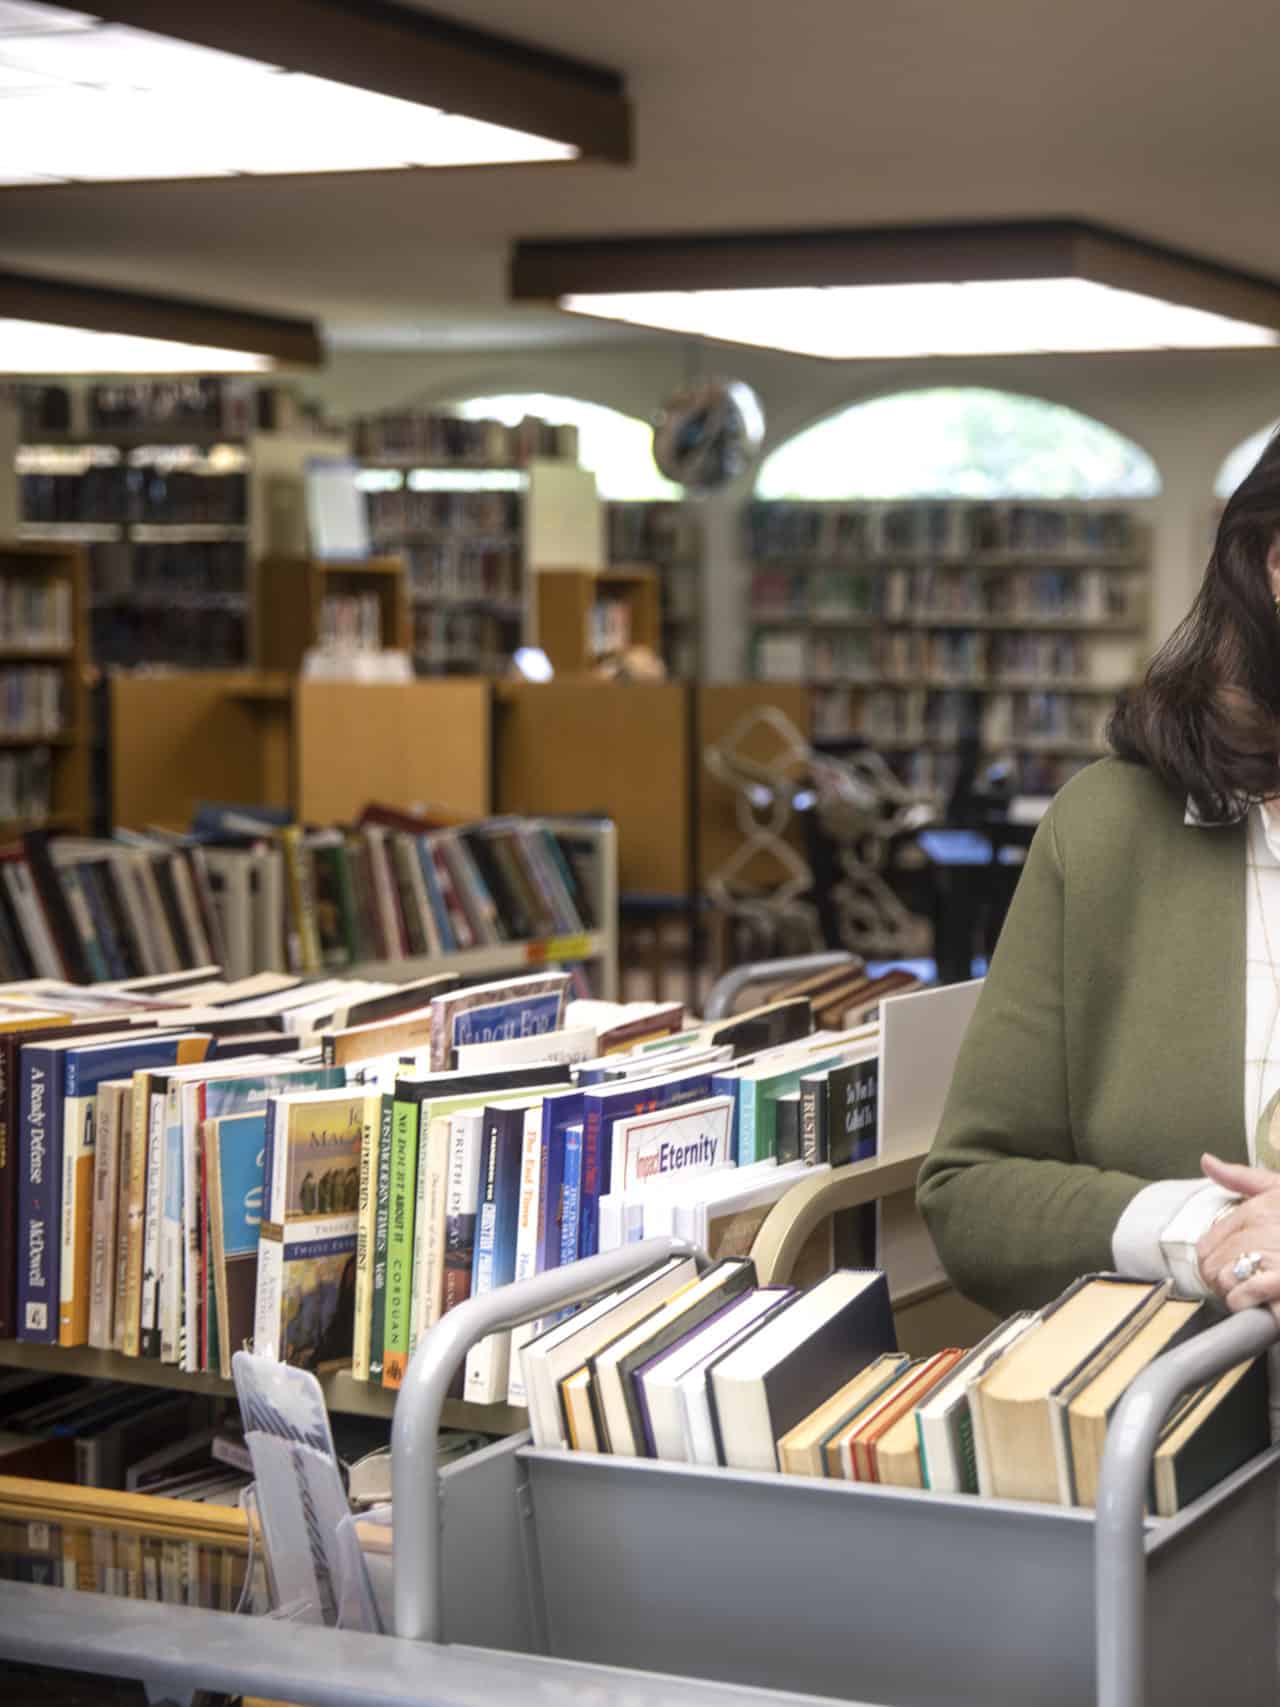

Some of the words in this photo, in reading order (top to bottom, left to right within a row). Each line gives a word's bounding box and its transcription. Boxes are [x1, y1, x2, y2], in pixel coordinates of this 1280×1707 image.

[32, 1067, 45, 1079] A
[27, 1083, 44, 1124] Ready
[29, 1128, 44, 1184] Defense
[378, 1109, 391, 1203] POSTMODERN
[396, 1138, 408, 1190] DOUBT
[453, 1128, 465, 1185] TRUTH
[659, 1133, 719, 1173] Eternity
[376, 1209, 388, 1252] TIMES
[393, 1232, 404, 1243] IT
[394, 1194, 406, 1229] ABOUT
[449, 1192, 463, 1247] DECAY
[29, 1219, 44, 1287] McDowell
[391, 1260, 402, 1344] CORDUAN
